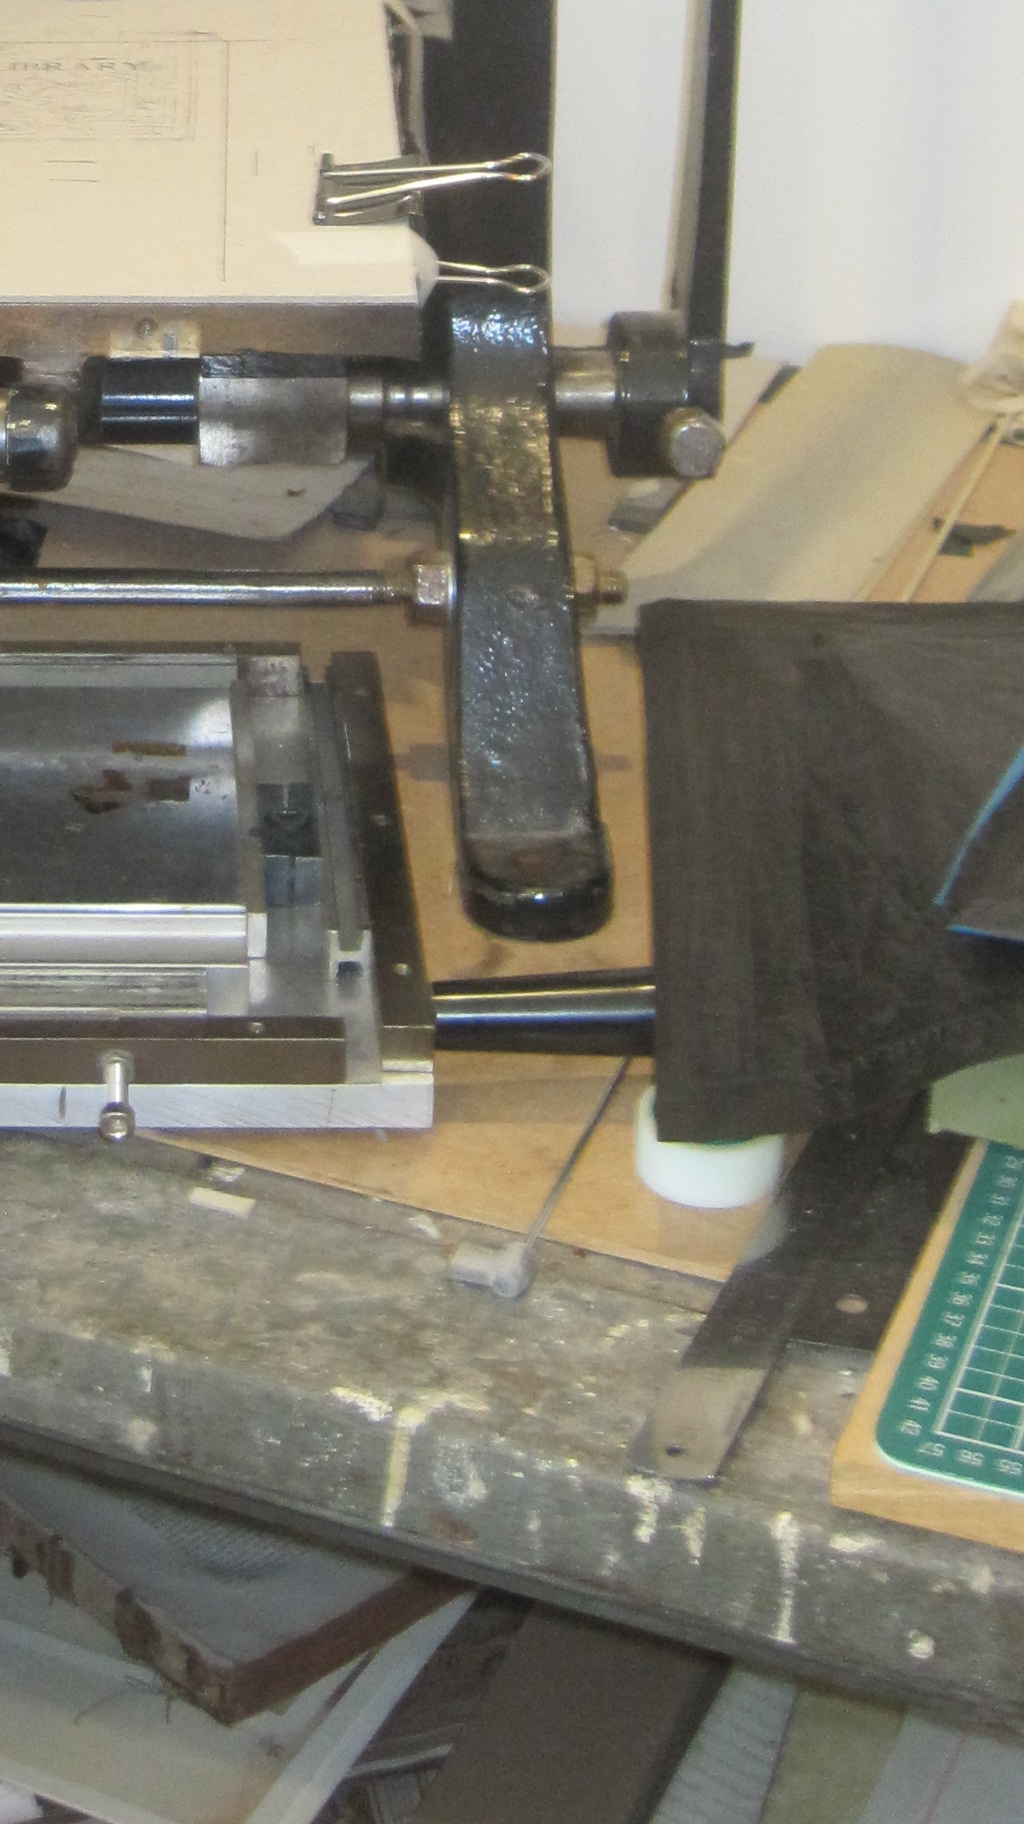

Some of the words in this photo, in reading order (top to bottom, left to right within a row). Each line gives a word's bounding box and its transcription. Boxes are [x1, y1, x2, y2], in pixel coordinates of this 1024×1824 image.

[944, 1312, 964, 1327] 37
[935, 1335, 956, 1348] 38
[927, 1354, 948, 1369] 39
[918, 1376, 938, 1390] 40
[910, 1398, 930, 1411] 41
[900, 1420, 921, 1435] 42
[918, 1441, 946, 1457] 57
[958, 1450, 983, 1466] 56
[996, 1458, 1023, 1475] 55
